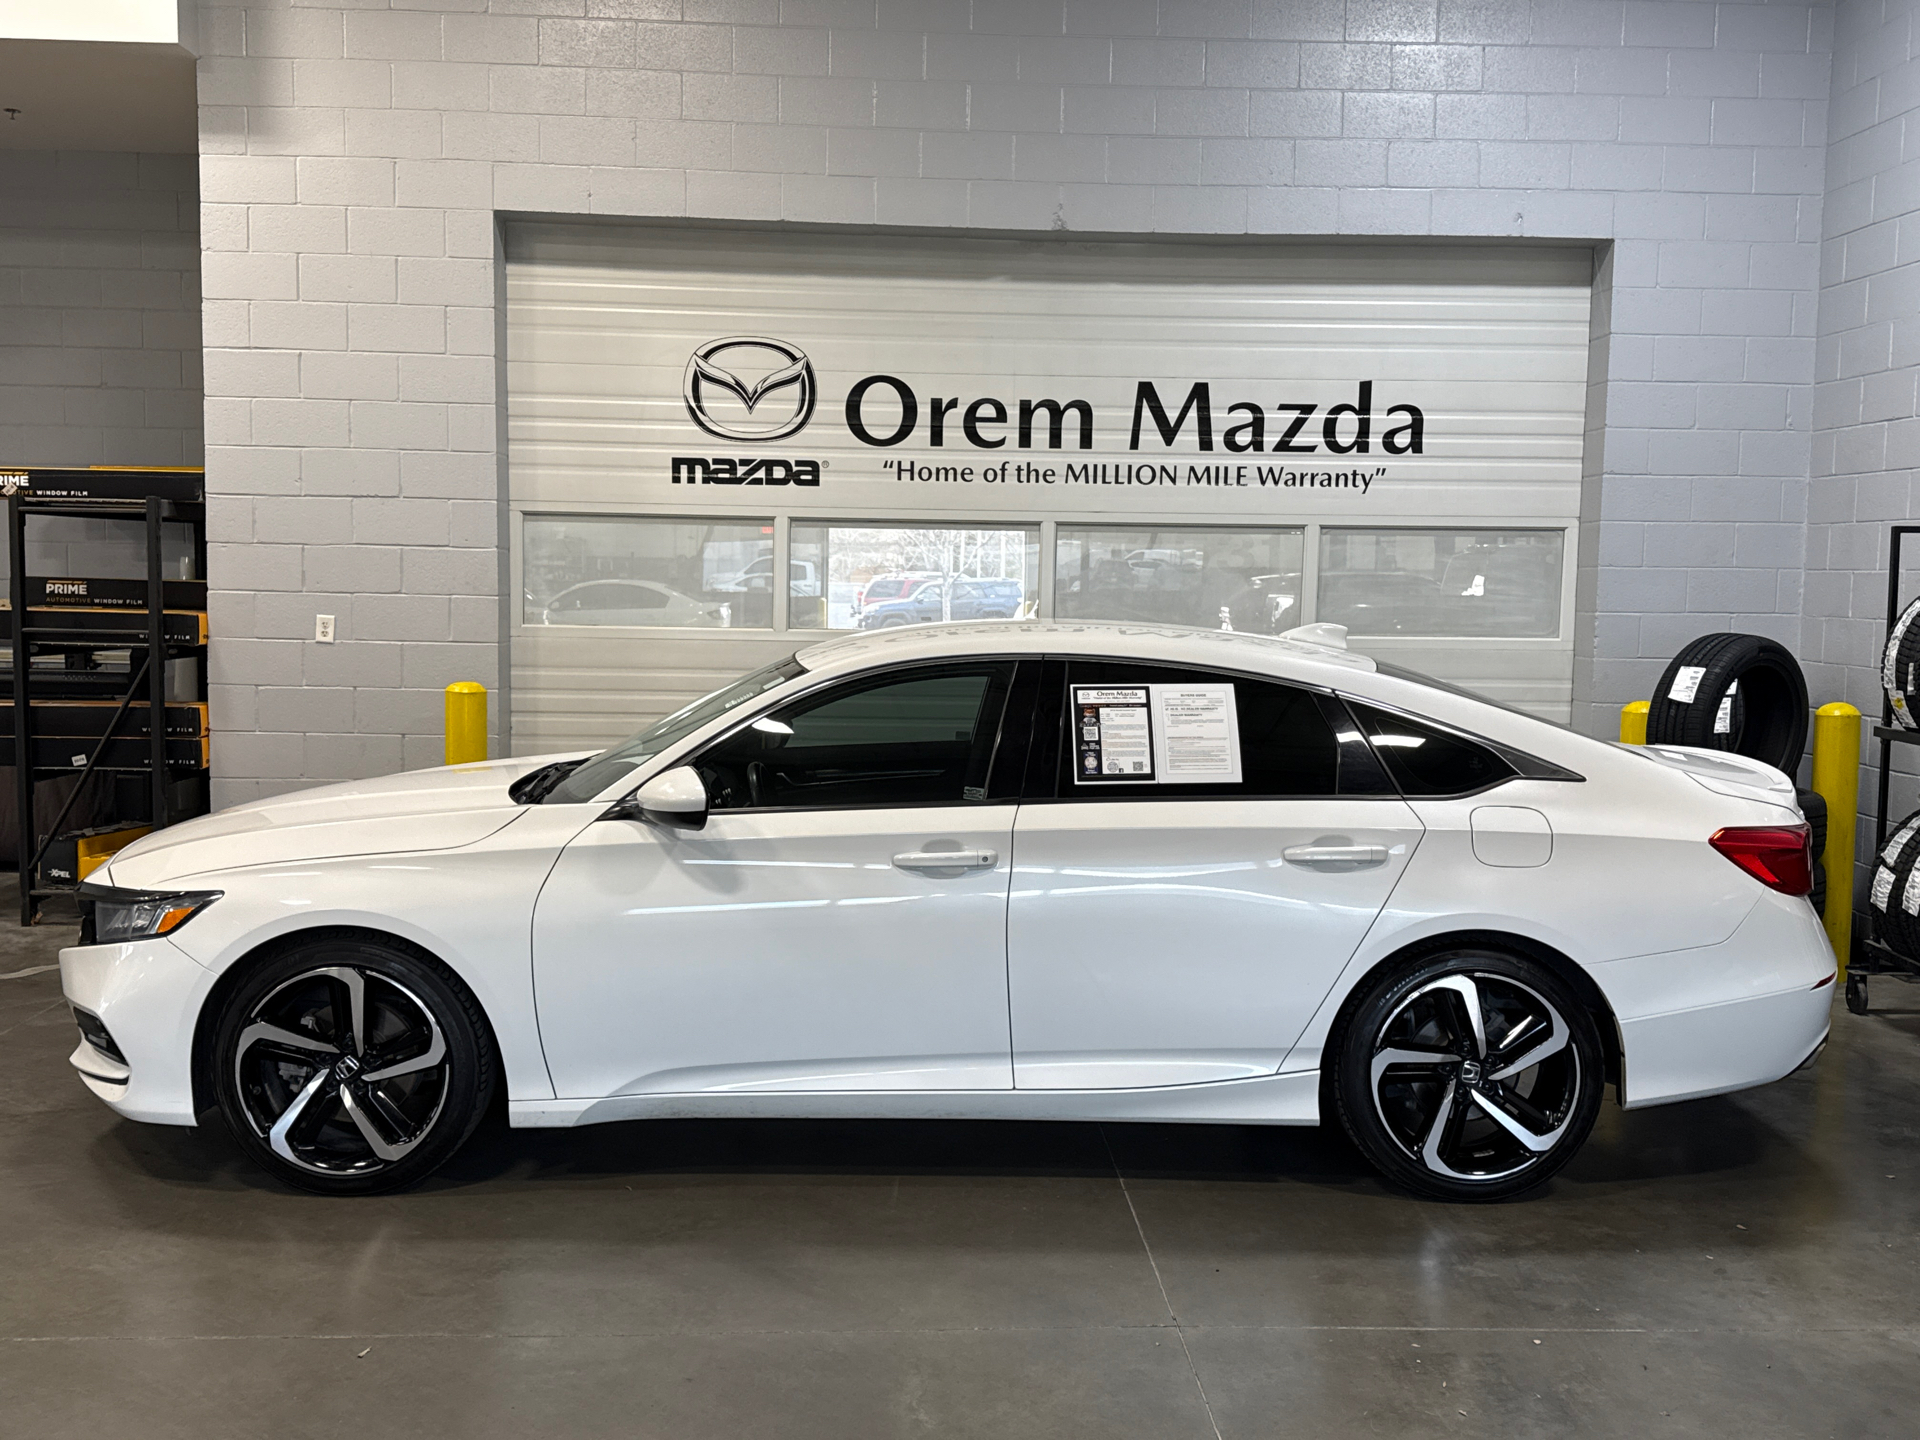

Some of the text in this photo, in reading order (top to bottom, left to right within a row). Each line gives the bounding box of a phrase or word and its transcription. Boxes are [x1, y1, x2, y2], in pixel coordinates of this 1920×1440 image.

[845, 374, 1424, 455] Orem Mazda
[983, 461, 1010, 483] of
[1015, 461, 1056, 484] the
[1065, 463, 1177, 486] MILLION
[1187, 465, 1248, 487] MILE
[46, 583, 87, 594] PRIME
[49, 868, 70, 878] XPEL
